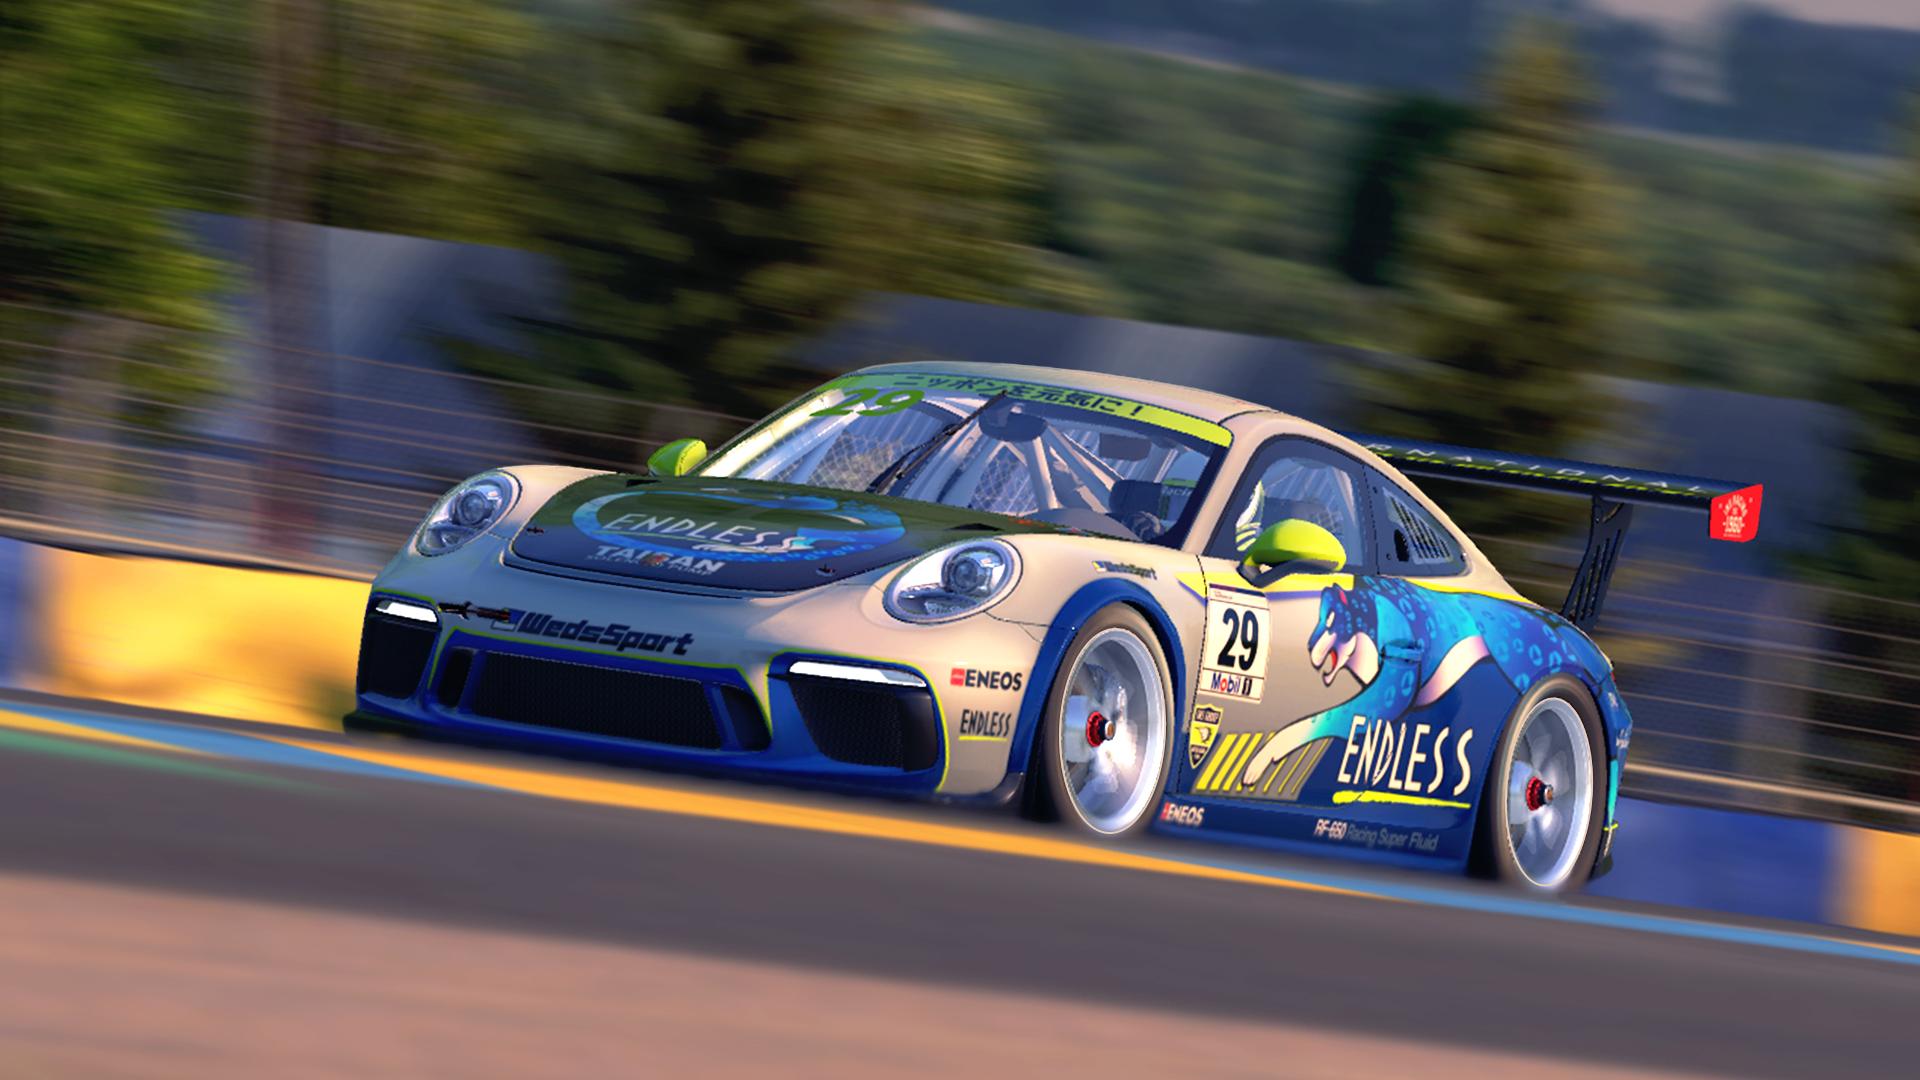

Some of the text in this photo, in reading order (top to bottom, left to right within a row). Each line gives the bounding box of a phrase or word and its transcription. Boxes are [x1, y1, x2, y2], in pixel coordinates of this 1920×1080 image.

[807, 387, 925, 417] 29
[602, 513, 807, 554] ENDLESS
[517, 612, 693, 656] WedsSport
[1217, 607, 1259, 671] 29
[965, 668, 1022, 691] ENEOS
[1211, 672, 1241, 694] Mobil
[960, 708, 1012, 737] ENDLESS
[1337, 715, 1473, 796] ENDLESS
[1167, 803, 1205, 826] ENEOS
[1346, 823, 1378, 848] Racing
[1377, 827, 1408, 849] Super
[1408, 831, 1440, 851] Fluid
